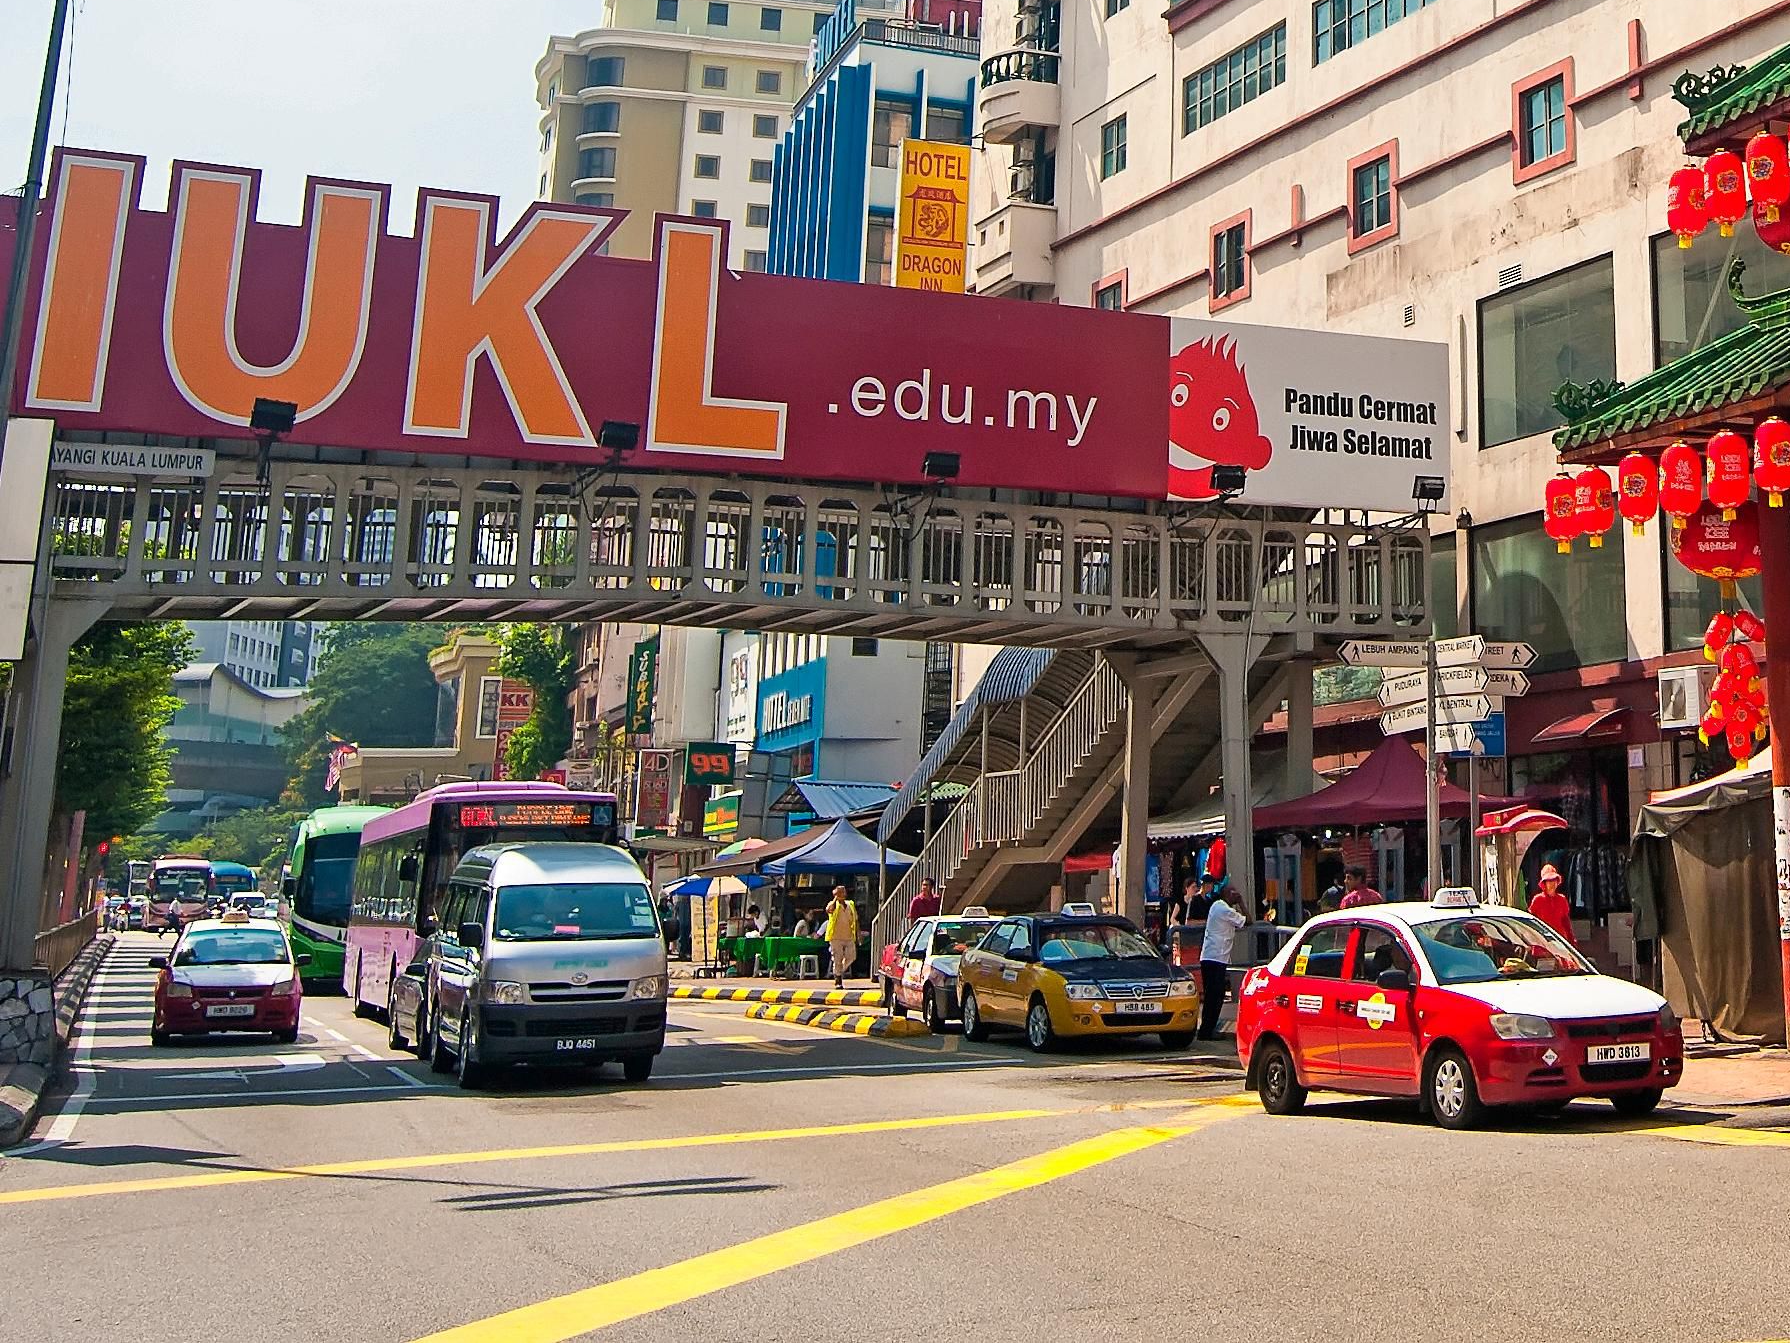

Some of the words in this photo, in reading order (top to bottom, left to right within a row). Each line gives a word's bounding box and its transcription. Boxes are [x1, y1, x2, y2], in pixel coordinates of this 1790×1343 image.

[905, 150, 967, 181] HOTEL
[902, 254, 962, 276] DRAGON
[920, 277, 943, 292] INN
[25, 154, 787, 460] IUKL
[827, 369, 1098, 448] .edu.my
[1284, 387, 1354, 420] Pandu
[1357, 394, 1437, 426] Cermat
[1289, 425, 1339, 454] Jiwa
[1343, 428, 1433, 461] Selamat
[101, 450, 146, 468] KUALA
[151, 453, 203, 471] LUMPUR
[1362, 645, 1386, 654] LEBUH
[1387, 645, 1419, 655] AMPANG
[632, 650, 650, 732] SUBWAY
[762, 689, 789, 735] HOTEL
[645, 753, 670, 772] 4D
[691, 752, 730, 776] 99
[557, 1039, 574, 1050] BJQ
[1597, 1047, 1616, 1060] HWD
[1618, 1046, 1641, 1059] 3813
